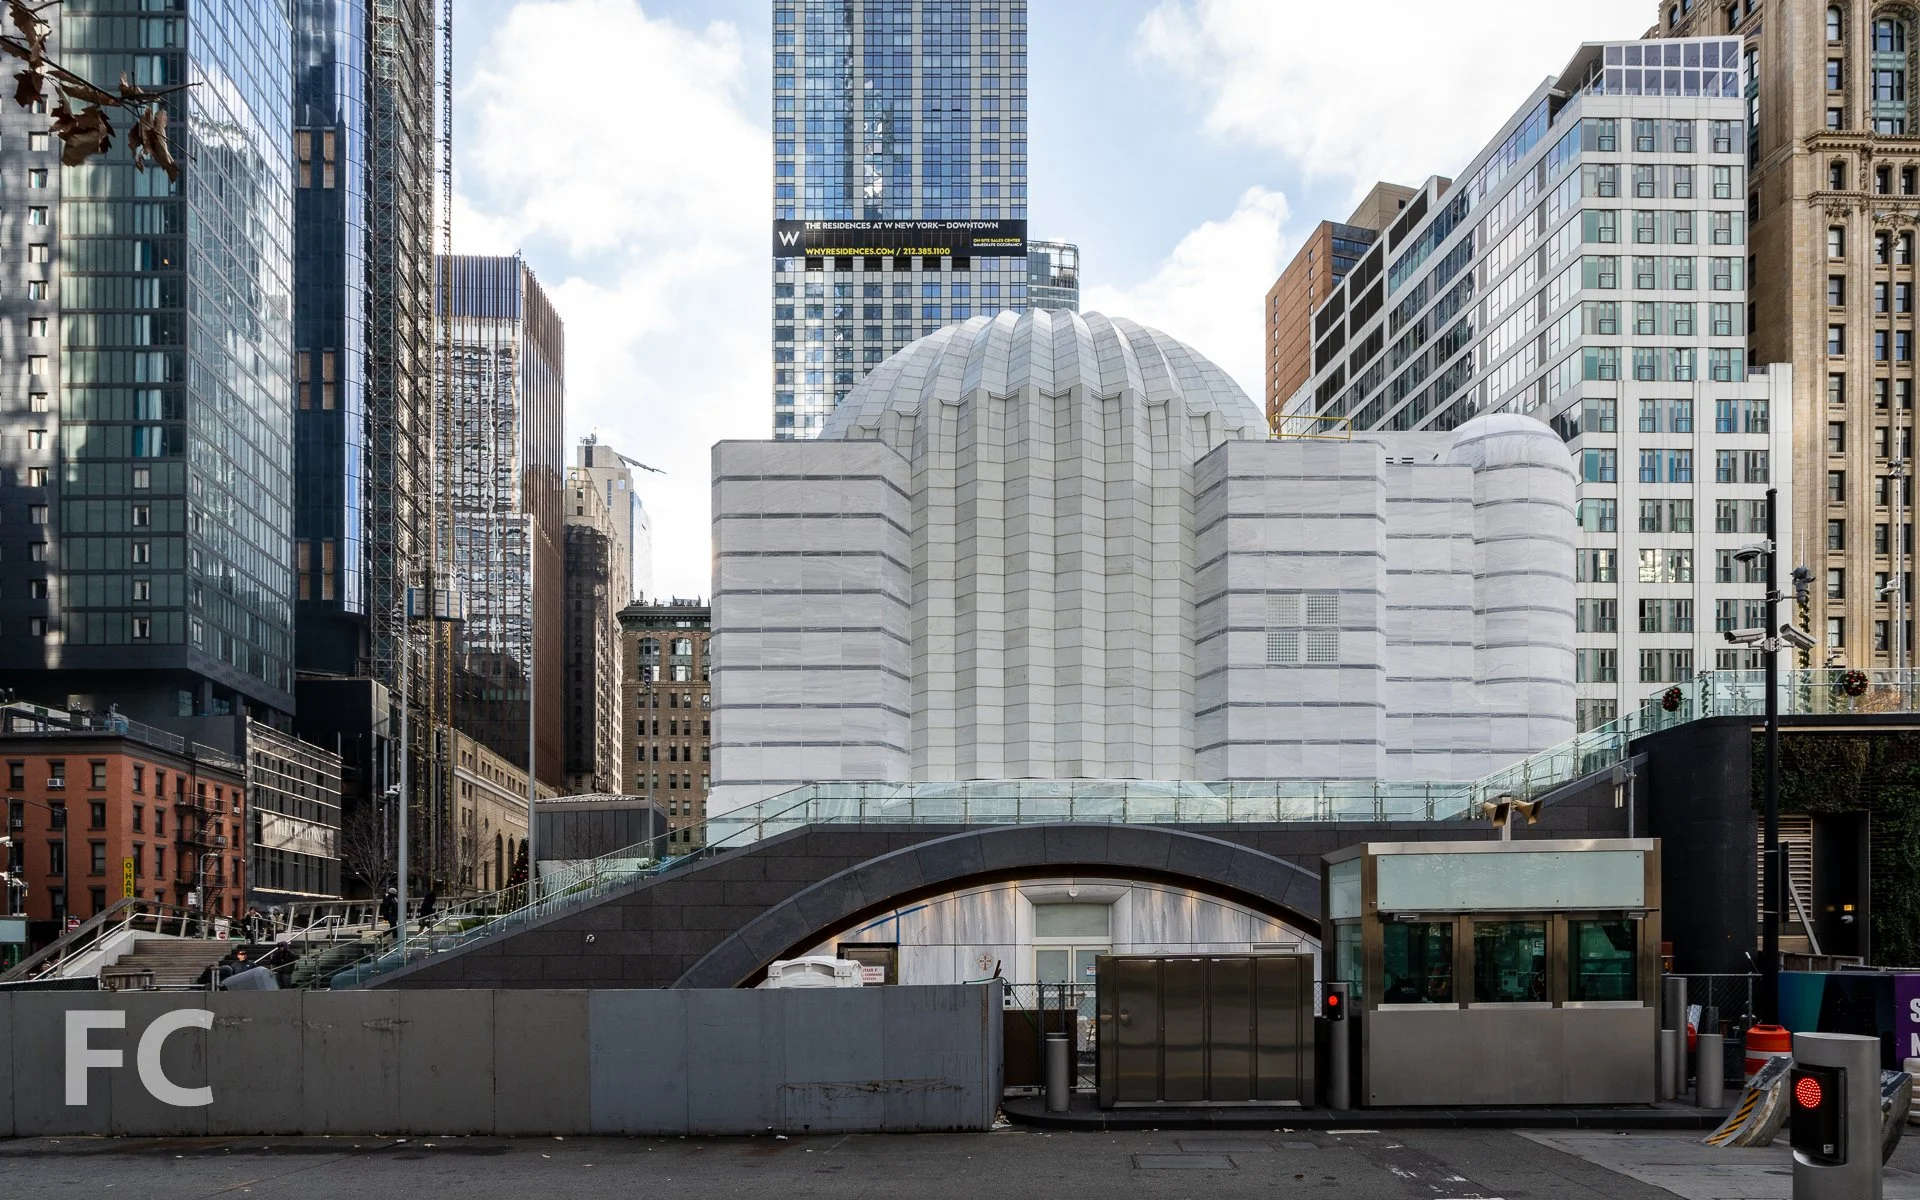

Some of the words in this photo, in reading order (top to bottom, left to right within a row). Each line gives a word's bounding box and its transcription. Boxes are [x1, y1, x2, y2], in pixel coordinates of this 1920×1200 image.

[778, 231, 800, 246] W
[805, 247, 895, 255] WNYRESIDENCES.COM
[903, 247, 951, 255] 212.385.1100
